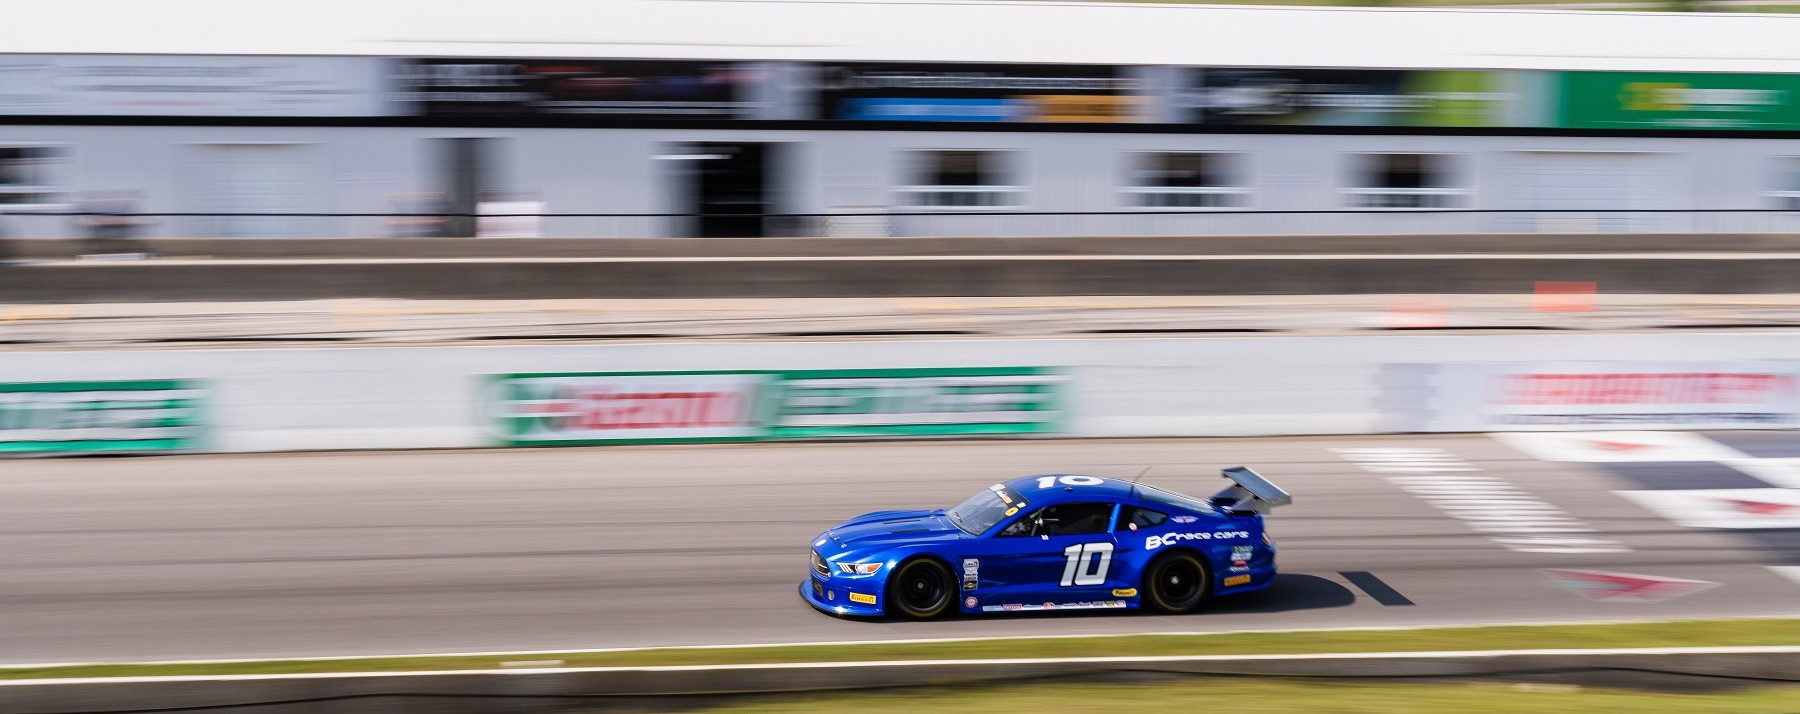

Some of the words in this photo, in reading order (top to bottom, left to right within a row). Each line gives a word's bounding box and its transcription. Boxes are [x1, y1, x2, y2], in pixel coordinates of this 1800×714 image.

[1036, 475, 1105, 489] 10
[1213, 530, 1249, 539] cars
[1060, 542, 1114, 587] 10
